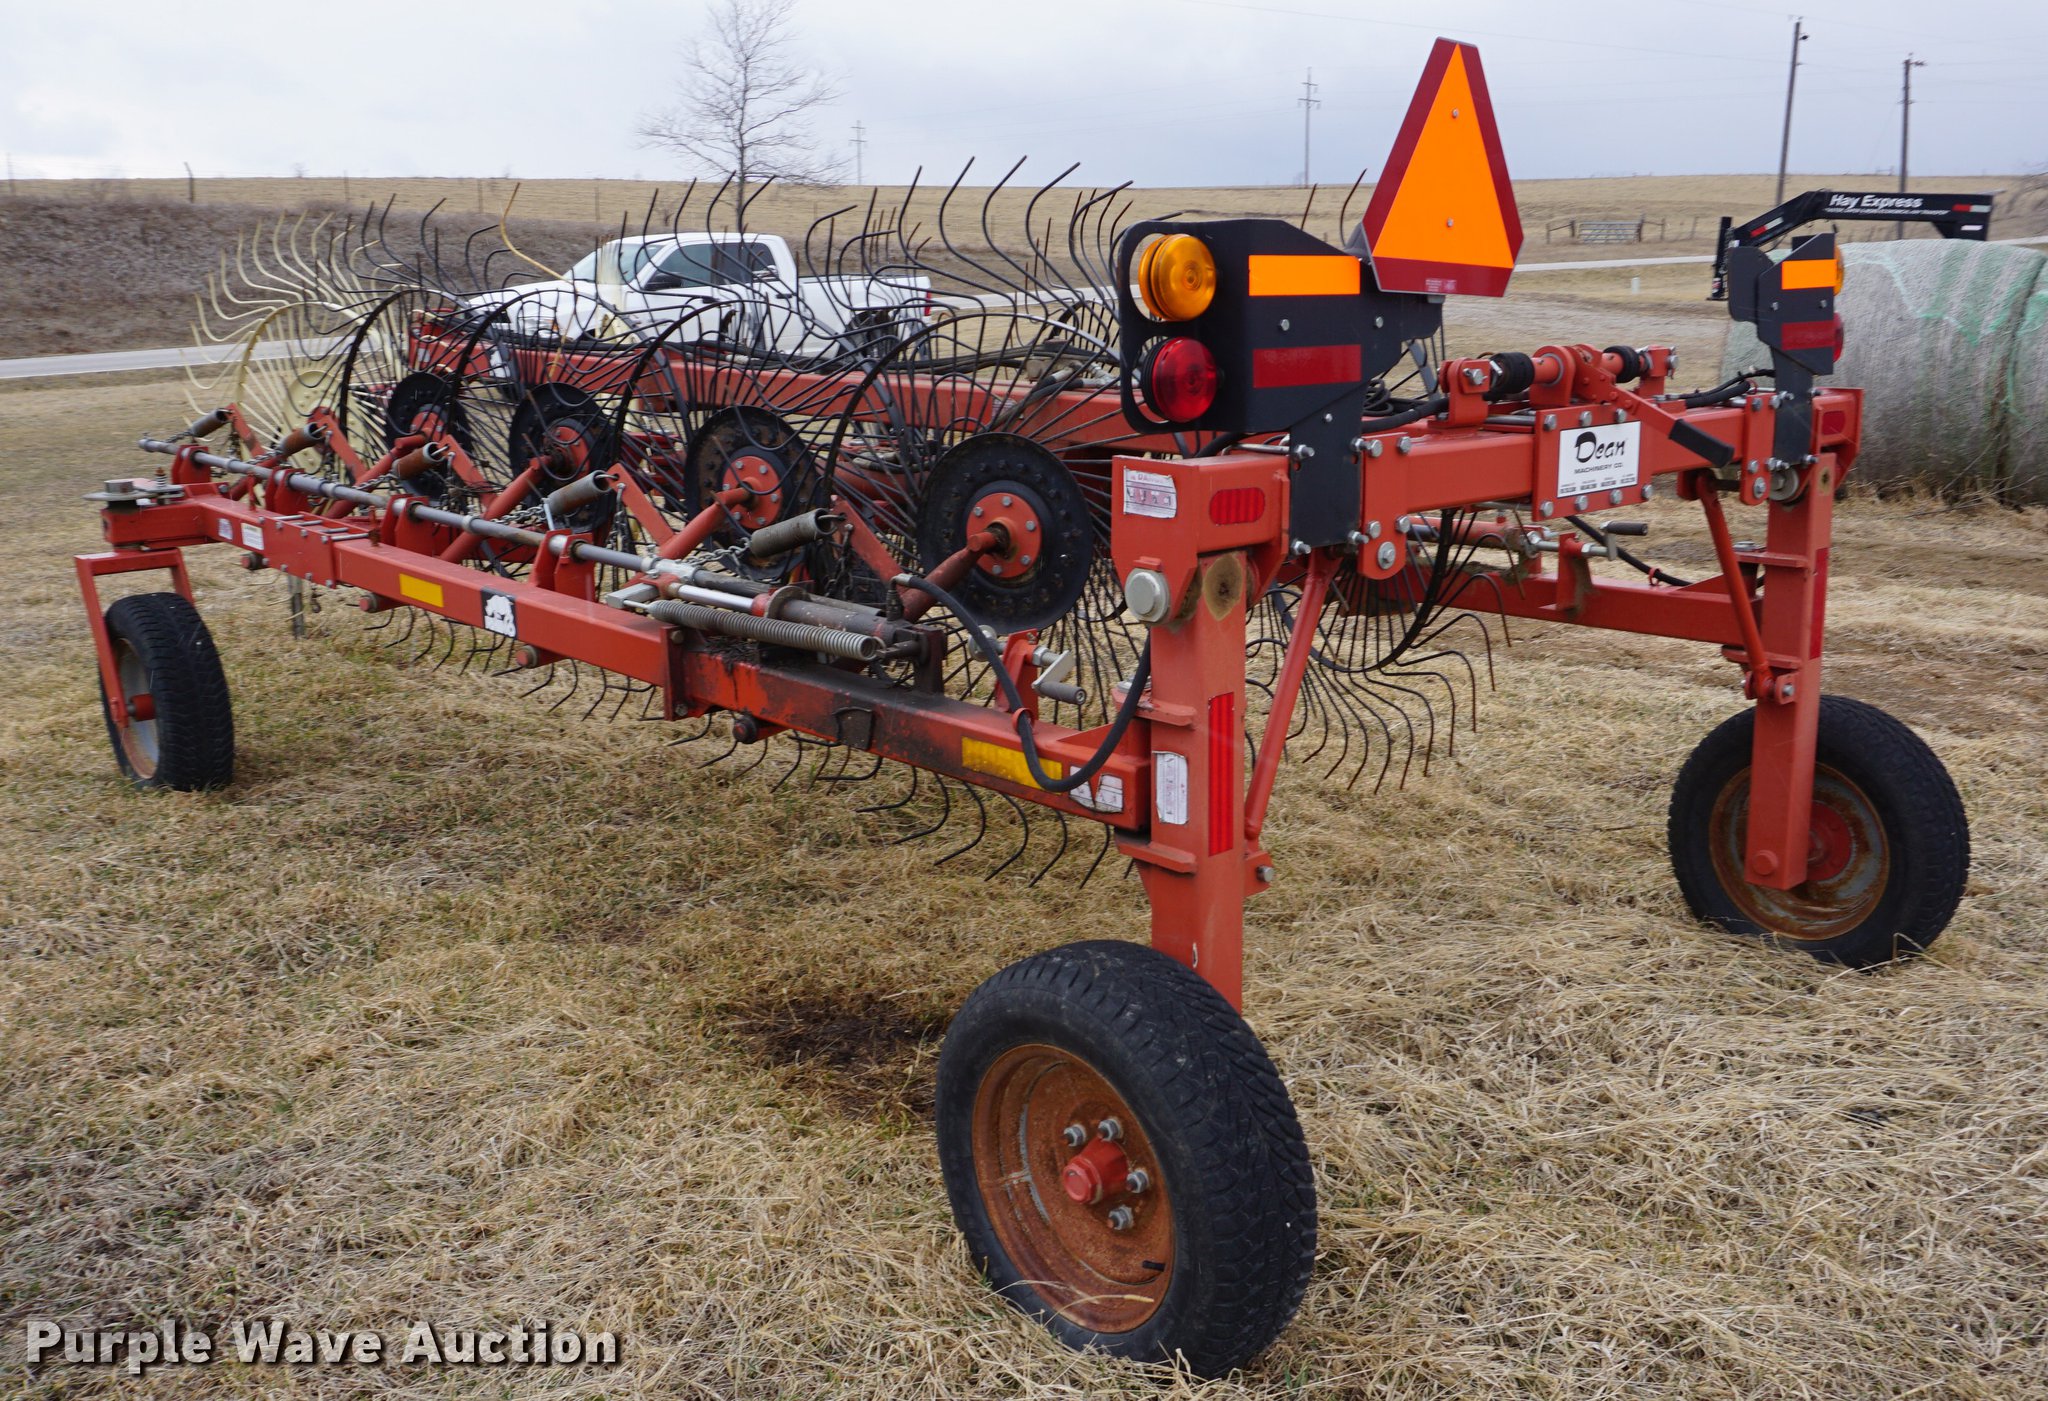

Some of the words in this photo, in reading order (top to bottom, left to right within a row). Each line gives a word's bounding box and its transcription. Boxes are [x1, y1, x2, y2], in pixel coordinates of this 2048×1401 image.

[1829, 194, 1860, 208] Hay
[1861, 195, 1923, 208] Express
[1574, 431, 1625, 463] Dean
[1574, 464, 1612, 474] MACHINERY
